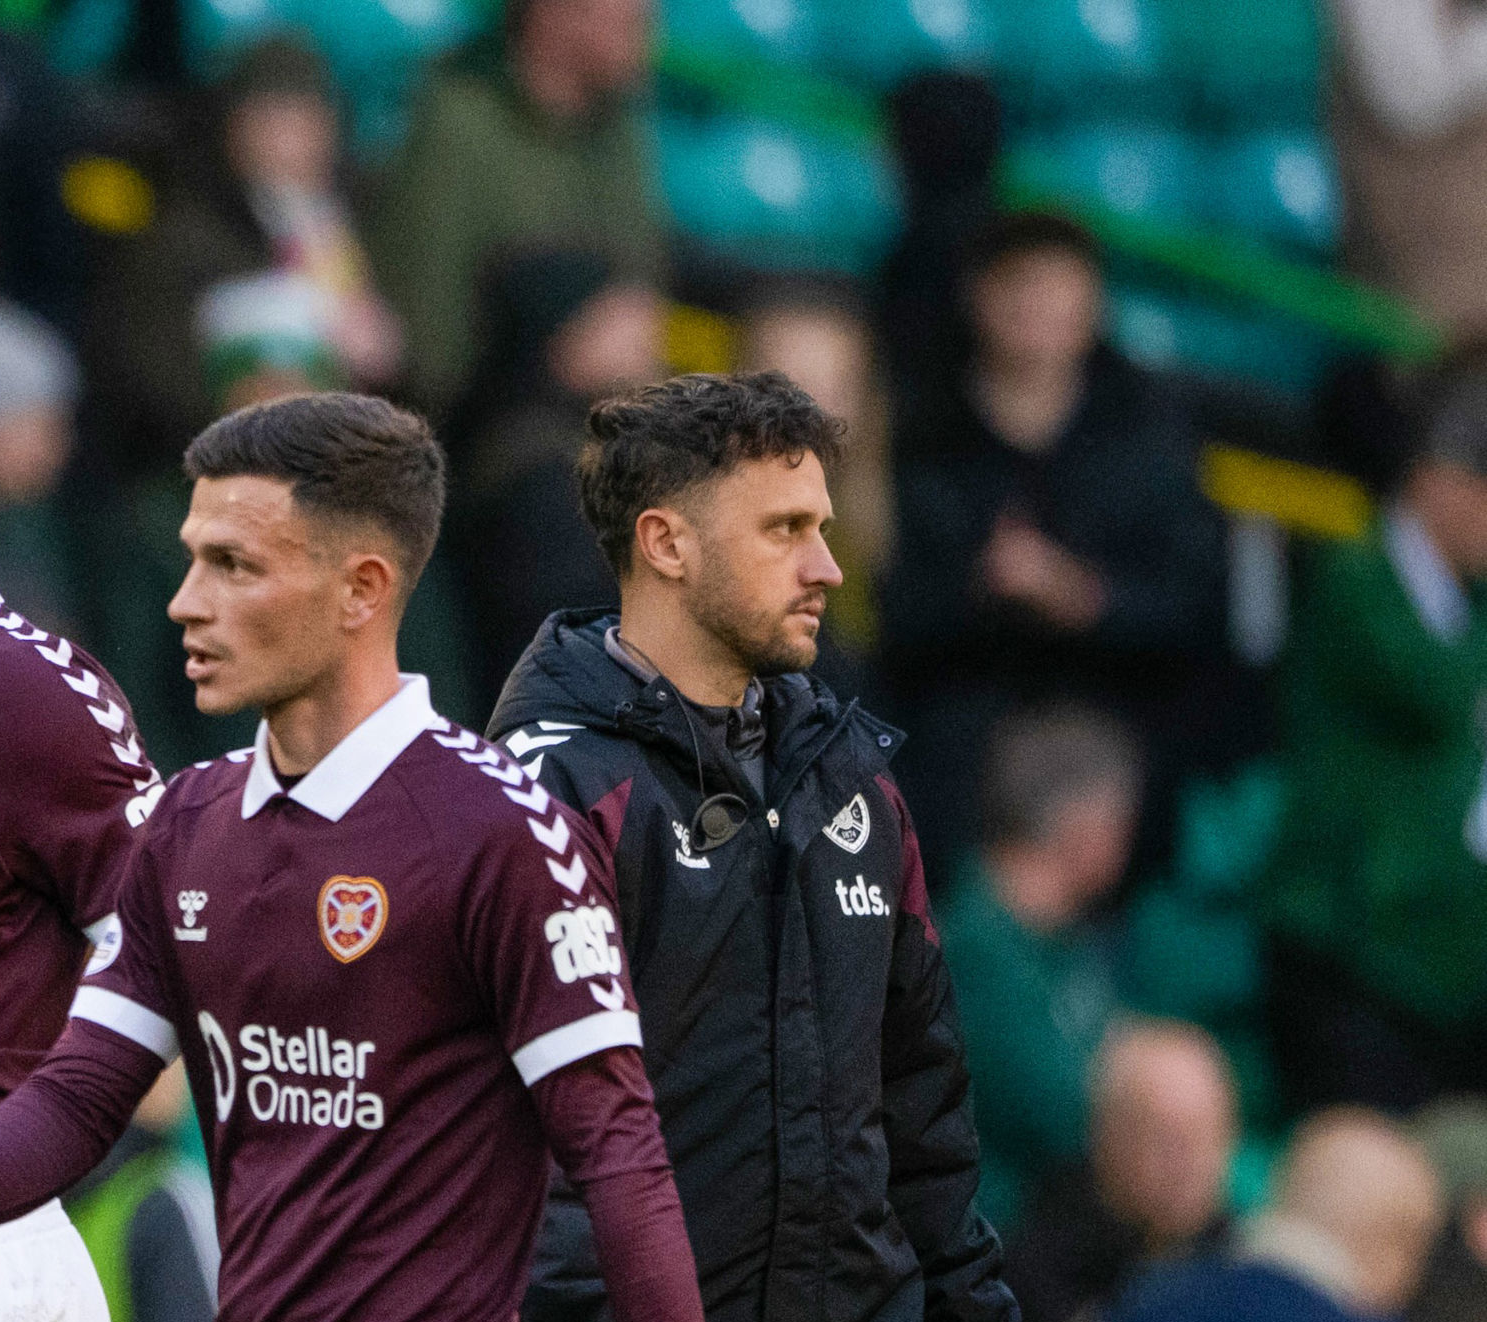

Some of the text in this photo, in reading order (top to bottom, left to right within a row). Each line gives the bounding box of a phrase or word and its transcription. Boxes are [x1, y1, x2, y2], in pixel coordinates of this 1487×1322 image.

[835, 875, 891, 916] tds.
[239, 1024, 376, 1079] Stellar
[247, 1074, 384, 1130] Omada
